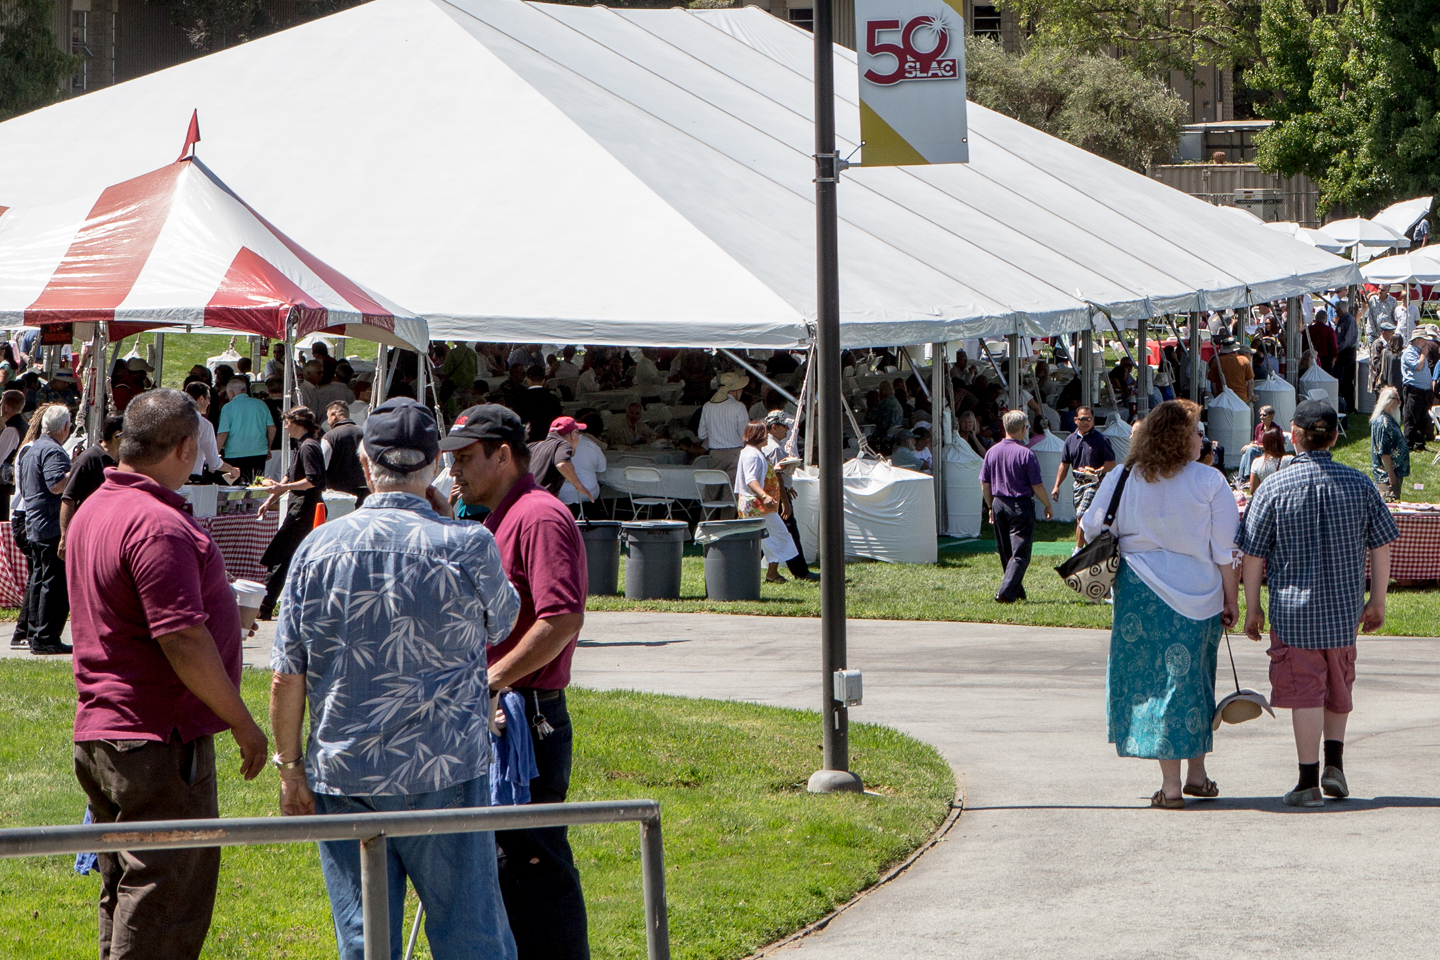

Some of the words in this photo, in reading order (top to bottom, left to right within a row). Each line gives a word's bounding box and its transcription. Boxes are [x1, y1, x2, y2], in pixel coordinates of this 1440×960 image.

[863, 15, 948, 85] 50
[904, 61, 954, 78] SLAC
[44, 332, 71, 342] SMOKING
